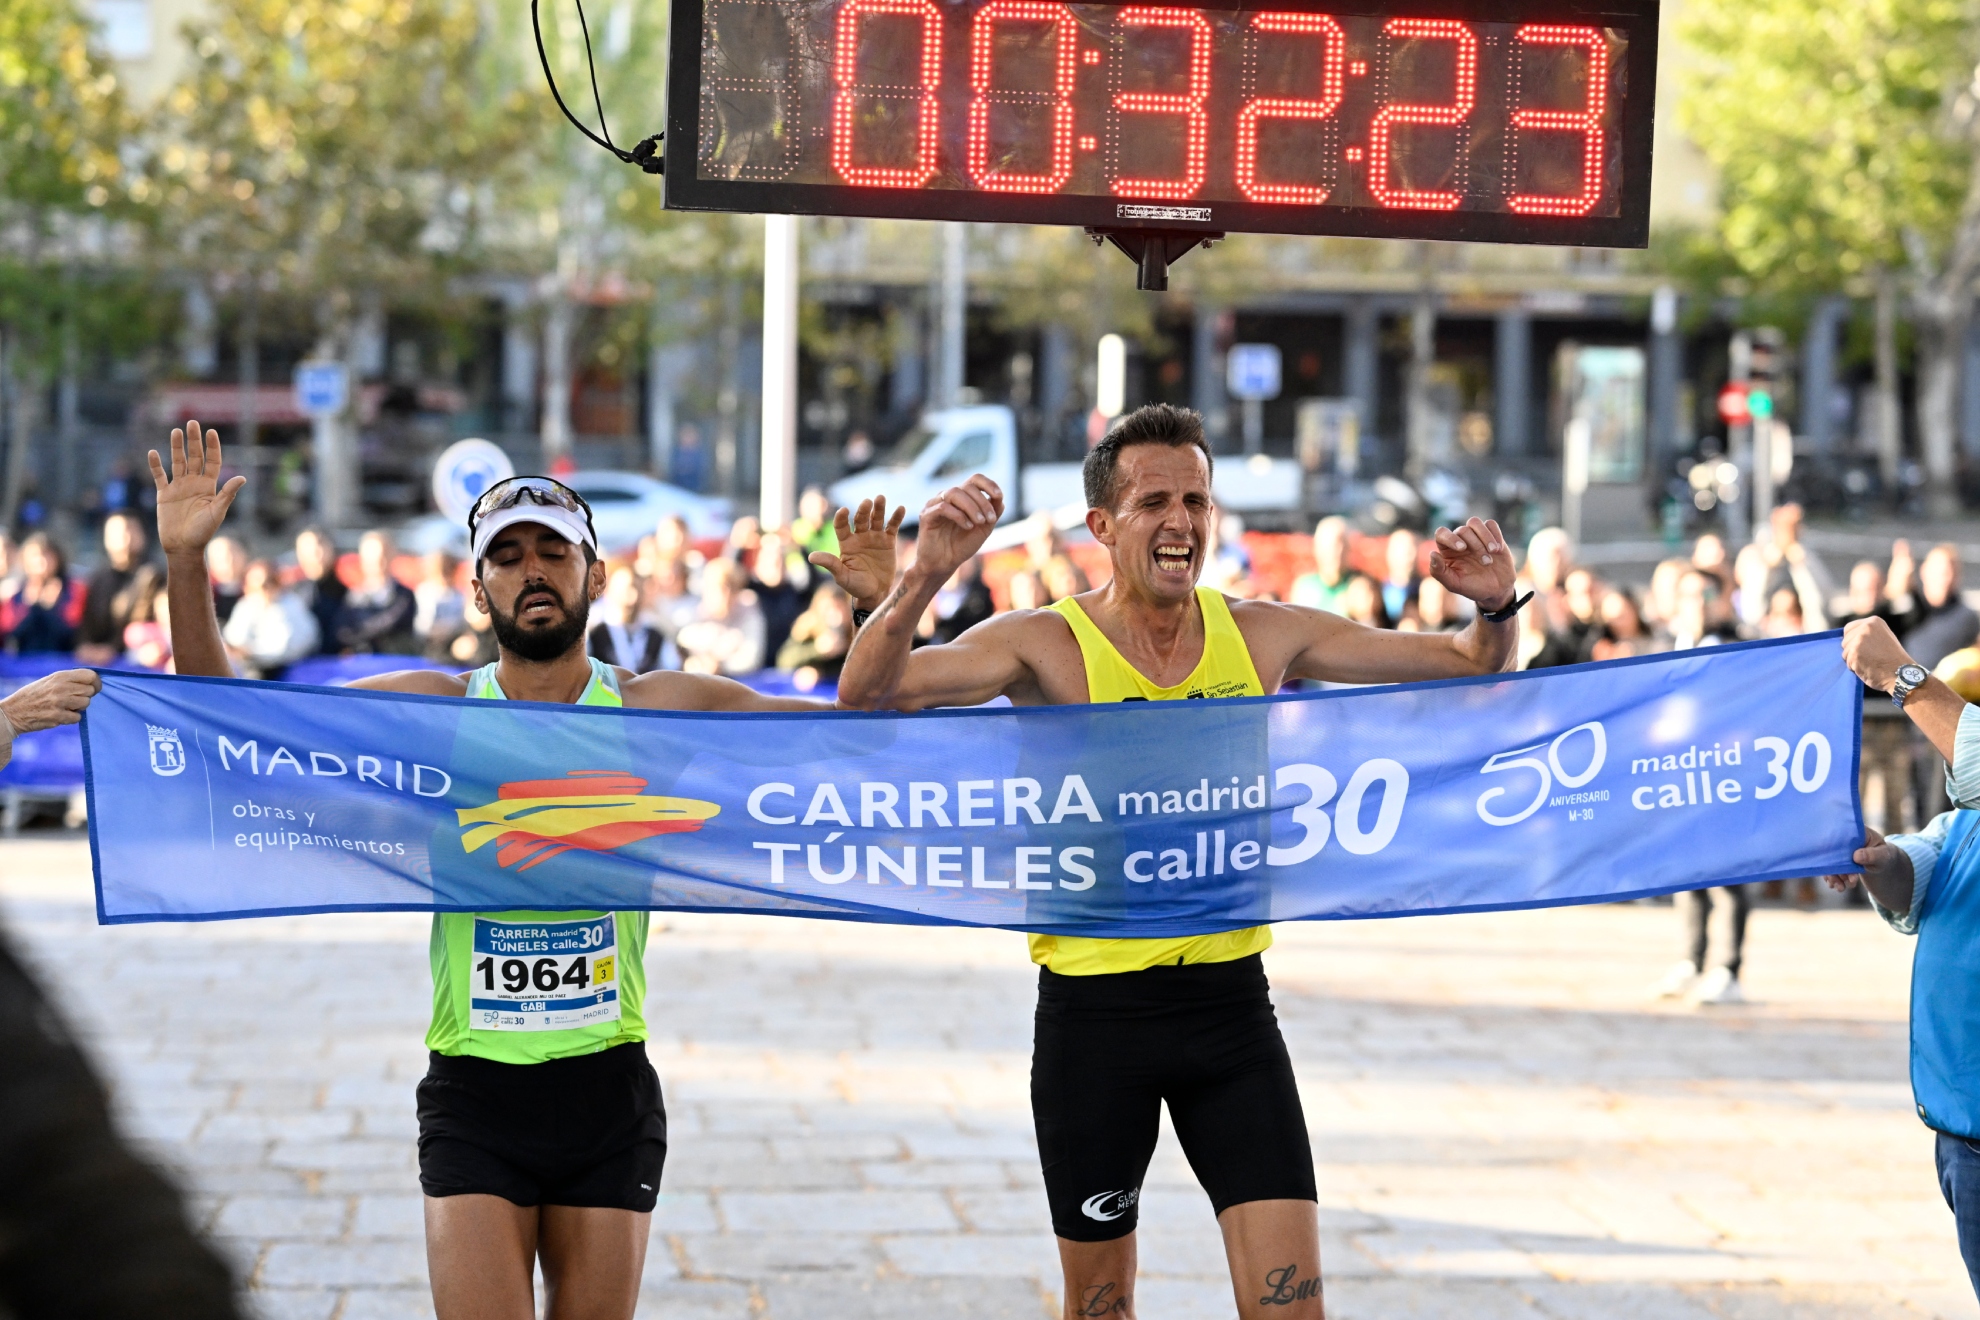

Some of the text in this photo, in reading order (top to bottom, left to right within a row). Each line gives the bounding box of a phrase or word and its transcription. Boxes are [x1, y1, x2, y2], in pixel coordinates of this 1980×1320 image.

[217, 735, 453, 798] MADRID
[1476, 721, 1608, 827] 50
[1631, 731, 1832, 800] madrid 30
[1549, 789, 1611, 808] ANIVERSARIO
[1631, 770, 1743, 811] calle
[232, 799, 316, 827] obras y
[746, 757, 1411, 867] CARRERA madrid 30
[1568, 808, 1595, 822] M-30
[234, 827, 406, 856] equipamientos
[751, 829, 1262, 892] TÚNELES calle
[490, 925, 604, 949] CARRERA madrid 30
[490, 937, 579, 952] TÚNELES calle
[476, 956, 590, 993] 1964
[601, 969, 607, 980] 3
[520, 1001, 547, 1012] GABI
[583, 1008, 609, 1020] MADRID
[514, 1017, 525, 1025] 30
